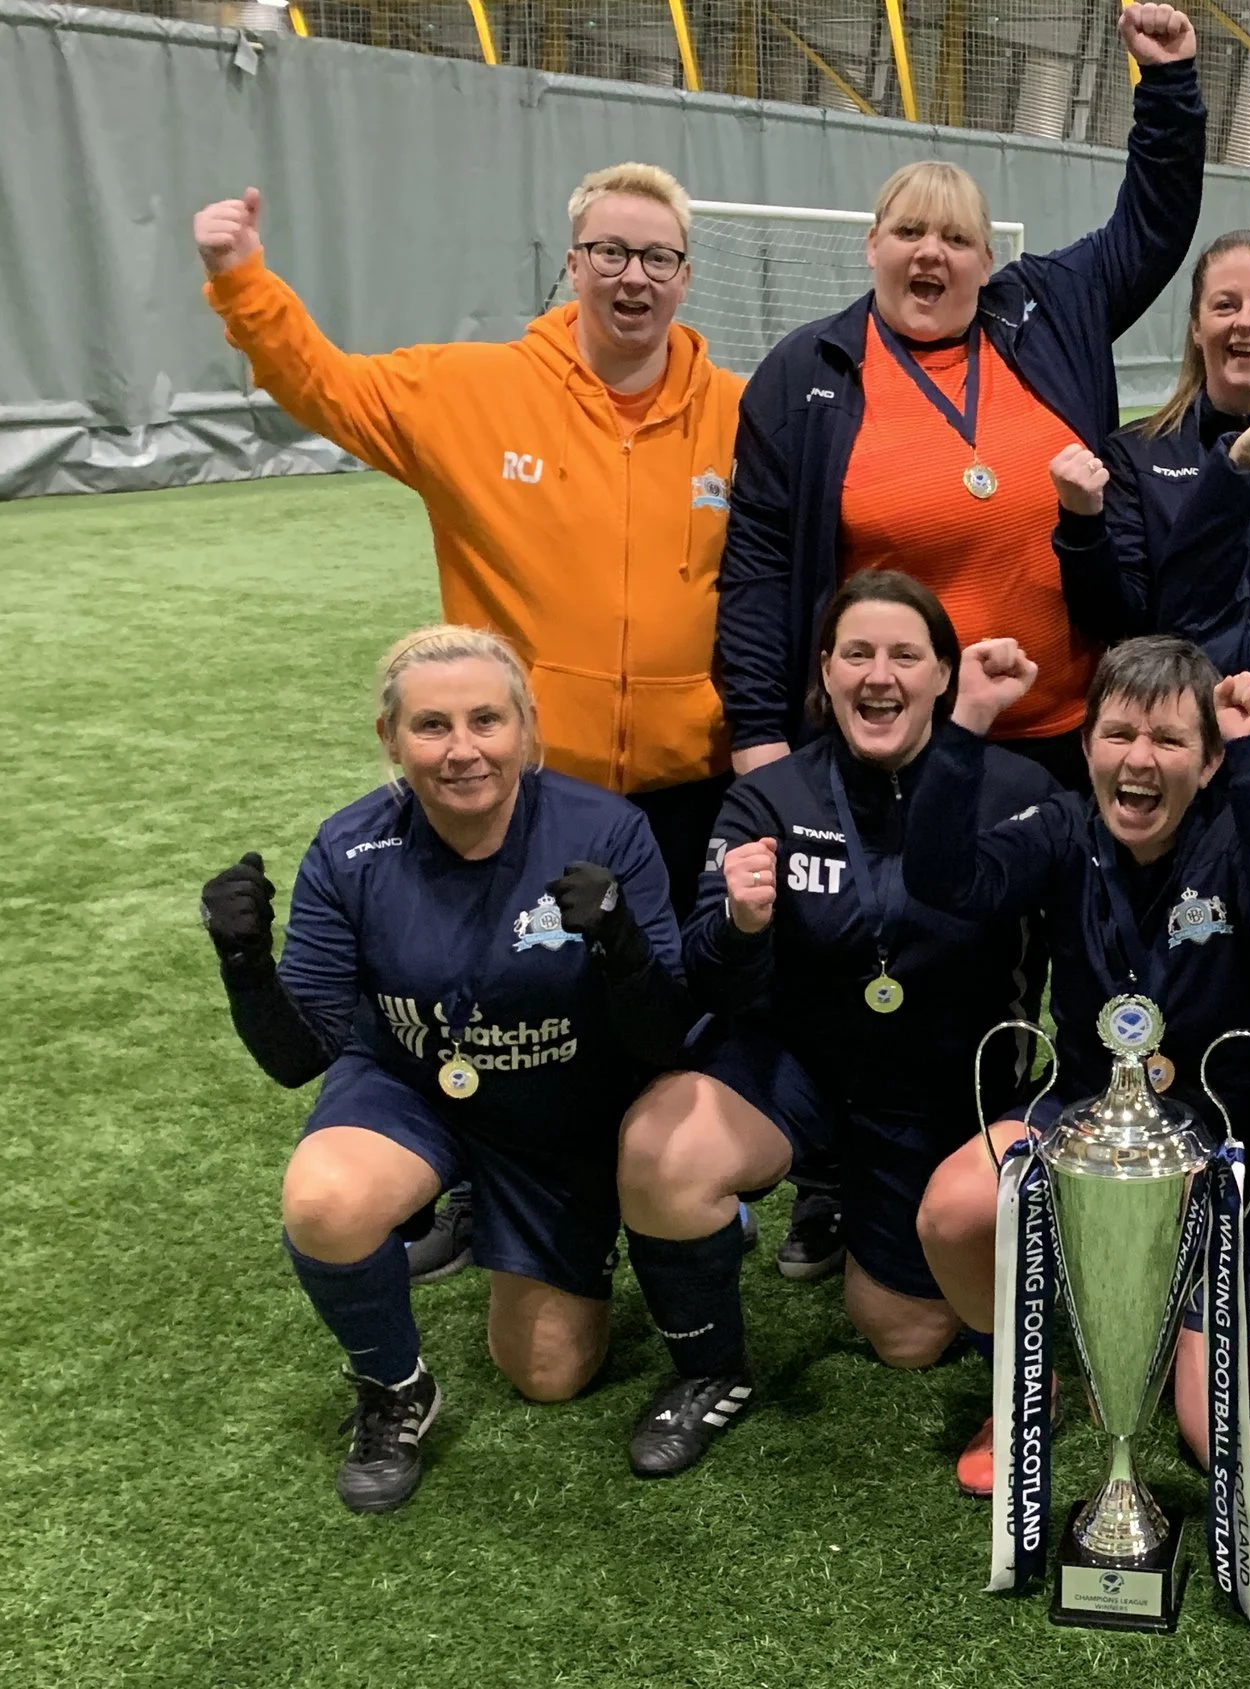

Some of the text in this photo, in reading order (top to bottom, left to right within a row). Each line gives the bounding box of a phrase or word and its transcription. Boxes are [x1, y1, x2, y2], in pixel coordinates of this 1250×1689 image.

[502, 451, 543, 484] RCJ
[345, 837, 403, 859] STANNO
[787, 852, 846, 894] SLT
[1215, 1214, 1233, 1328] WALKING
[1022, 1179, 1044, 1551] WALKING FOOTBALL SCOTLAND
[1214, 1333, 1231, 1457] FOOTBALL
[1214, 1464, 1233, 1593] SCOTLAND
[1074, 1593, 1149, 1606] CHAMPIONS LEAGUE
